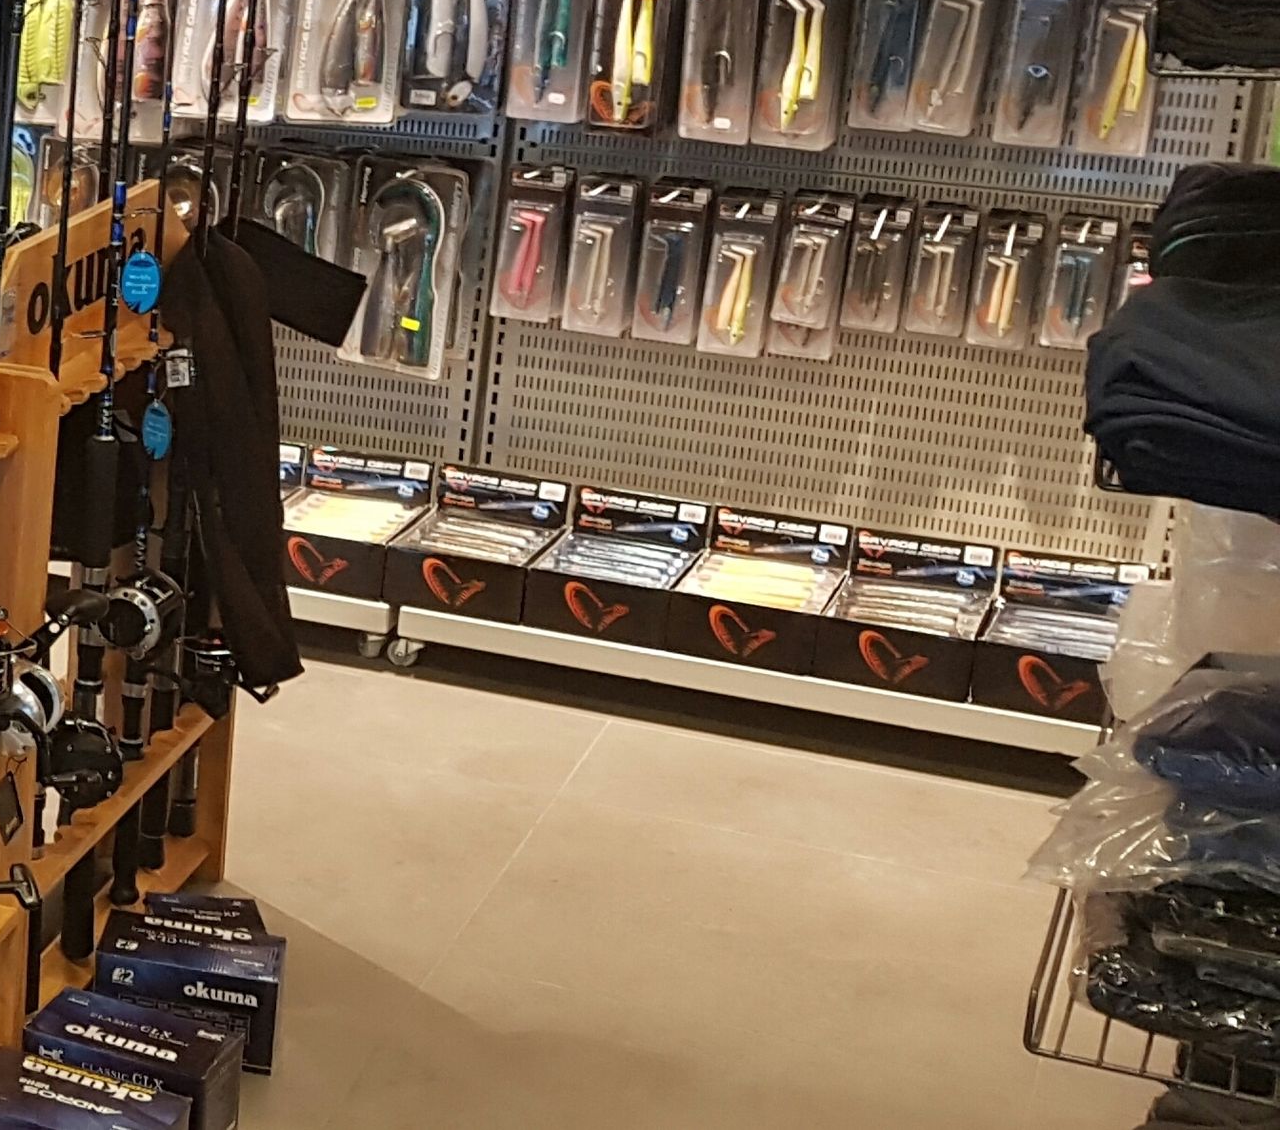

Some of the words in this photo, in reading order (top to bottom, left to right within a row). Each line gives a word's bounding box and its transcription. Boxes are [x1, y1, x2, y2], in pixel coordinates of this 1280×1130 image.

[144, 915, 253, 942] okuma
[183, 981, 259, 1009] okuma
[65, 1023, 178, 1063] okuma
[22, 1057, 154, 1104] okuma
[80, 1060, 130, 1082] CLASSIC
[20, 1085, 124, 1116] ANDROS
